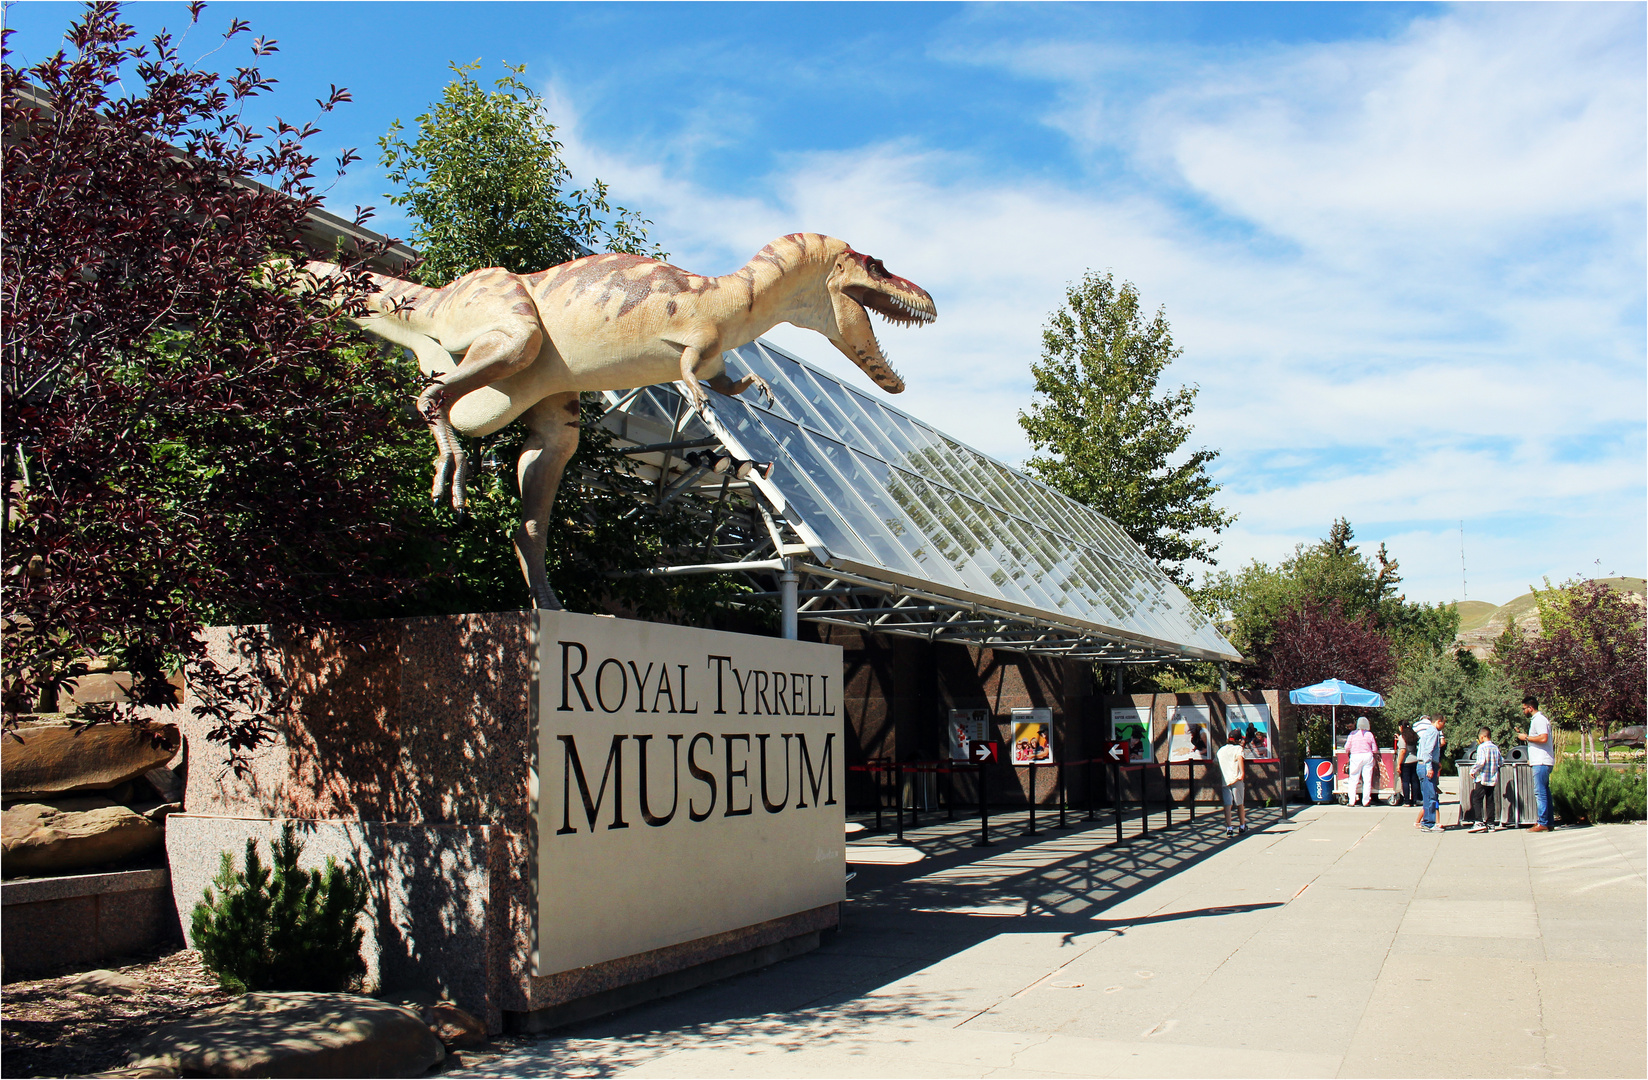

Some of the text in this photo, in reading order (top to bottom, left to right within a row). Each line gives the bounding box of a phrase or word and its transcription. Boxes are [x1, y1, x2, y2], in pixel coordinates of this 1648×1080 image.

[557, 640, 836, 716] ROYAL TYRRELL
[556, 732, 837, 835] MUSEUM
